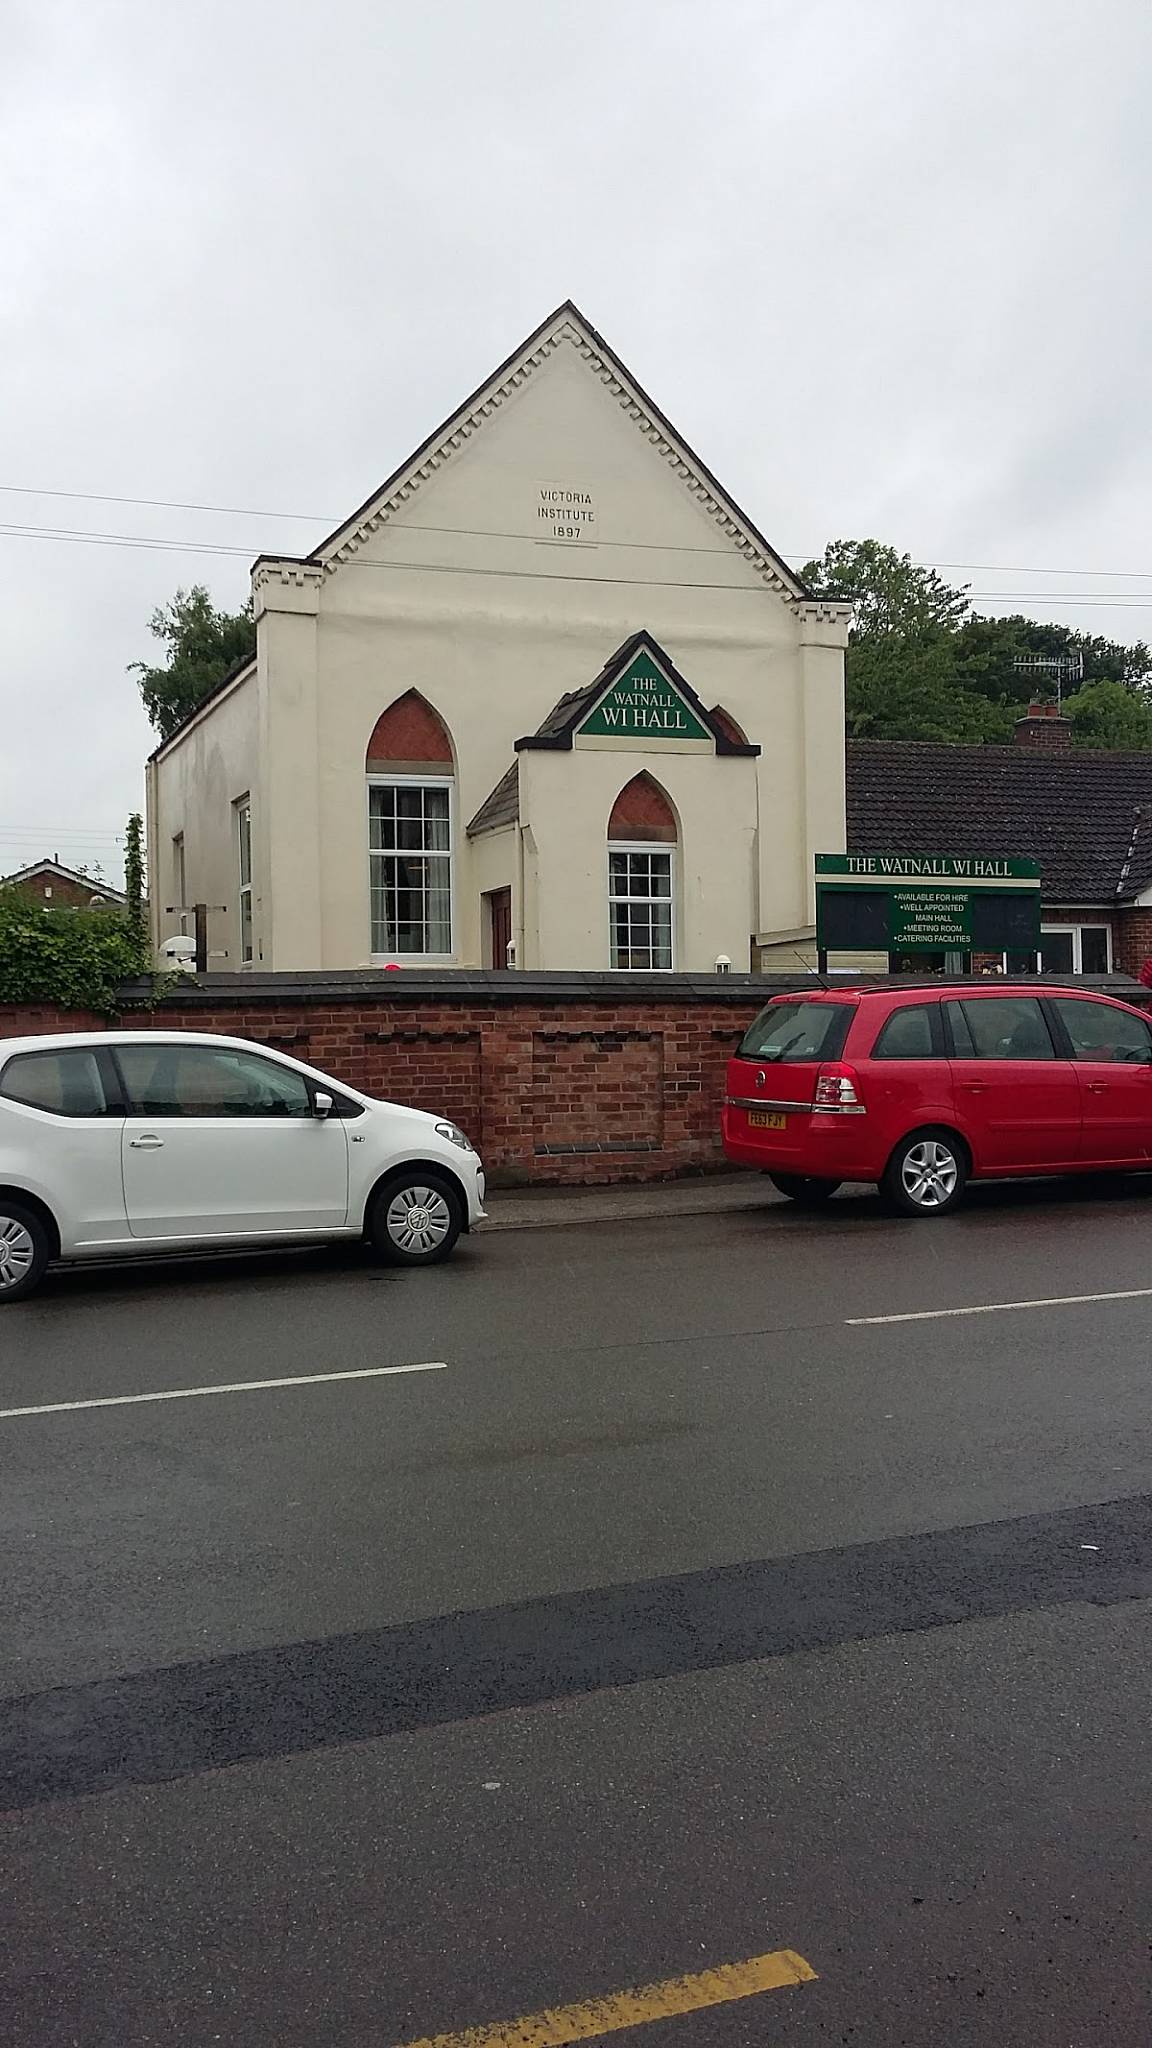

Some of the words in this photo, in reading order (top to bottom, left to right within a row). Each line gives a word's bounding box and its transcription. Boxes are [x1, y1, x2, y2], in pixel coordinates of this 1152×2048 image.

[540, 490, 592, 504] VICTORIA
[537, 507, 595, 522] INSTITUTE
[553, 525, 581, 538] 1897
[631, 677, 658, 691] THE
[613, 692, 676, 707] WATNALL
[601, 707, 628, 727] WI
[633, 708, 688, 729] HALL
[846, 857, 877, 873] THE
[880, 858, 950, 875] WATNALL
[952, 860, 971, 875] WI
[974, 860, 1012, 876] HALL
[935, 893, 951, 902] FOR
[951, 894, 969, 902] HIRE
[903, 903, 923, 911] WELL
[923, 904, 965, 912] APPOINTED
[915, 914, 933, 922] MAIN
[934, 914, 953, 922] HALL
[907, 924, 939, 932] MEETING
[897, 934, 934, 943] CATERING
[934, 935, 972, 943] FACILITIES
